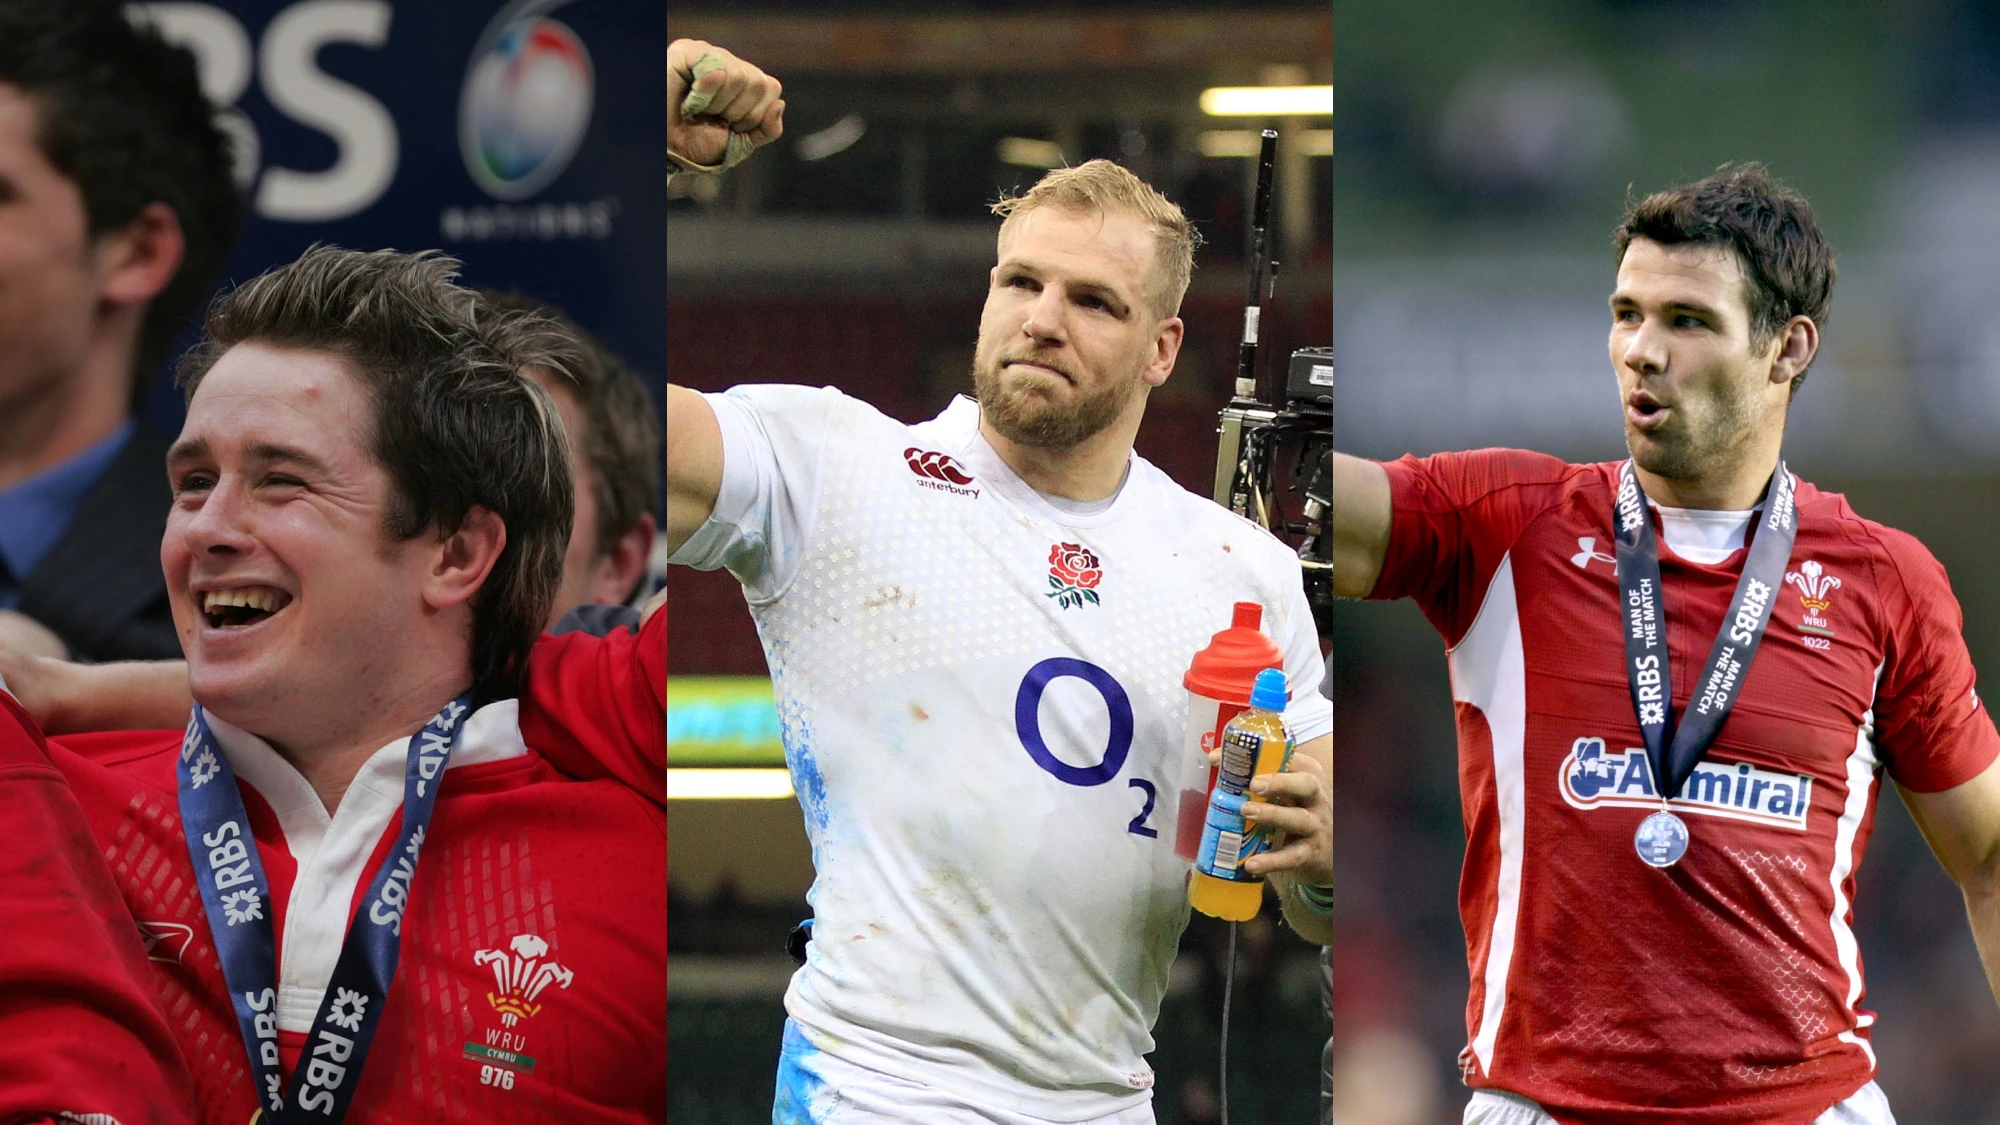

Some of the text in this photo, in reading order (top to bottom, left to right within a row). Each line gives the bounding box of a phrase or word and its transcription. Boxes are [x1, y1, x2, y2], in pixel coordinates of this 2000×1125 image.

[1618, 473, 1640, 515] RBS
[1629, 589, 1644, 638] MAN OF
[1640, 578, 1657, 649] THE MATCH
[1730, 597, 1764, 646] RBS
[1803, 614, 1827, 628] WRU
[1801, 636, 1831, 650] 1022
[1635, 655, 1662, 701] RBS
[1696, 646, 1735, 715] THE MATCH
[1713, 660, 1741, 711] MAN OF
[1616, 753, 1810, 818] Amiral
[203, 820, 254, 891] RBS
[486, 1027, 526, 1052] WRU
[487, 1047, 517, 1063] CYMRU
[298, 1029, 355, 1116] RBS
[480, 1064, 515, 1091] 976
